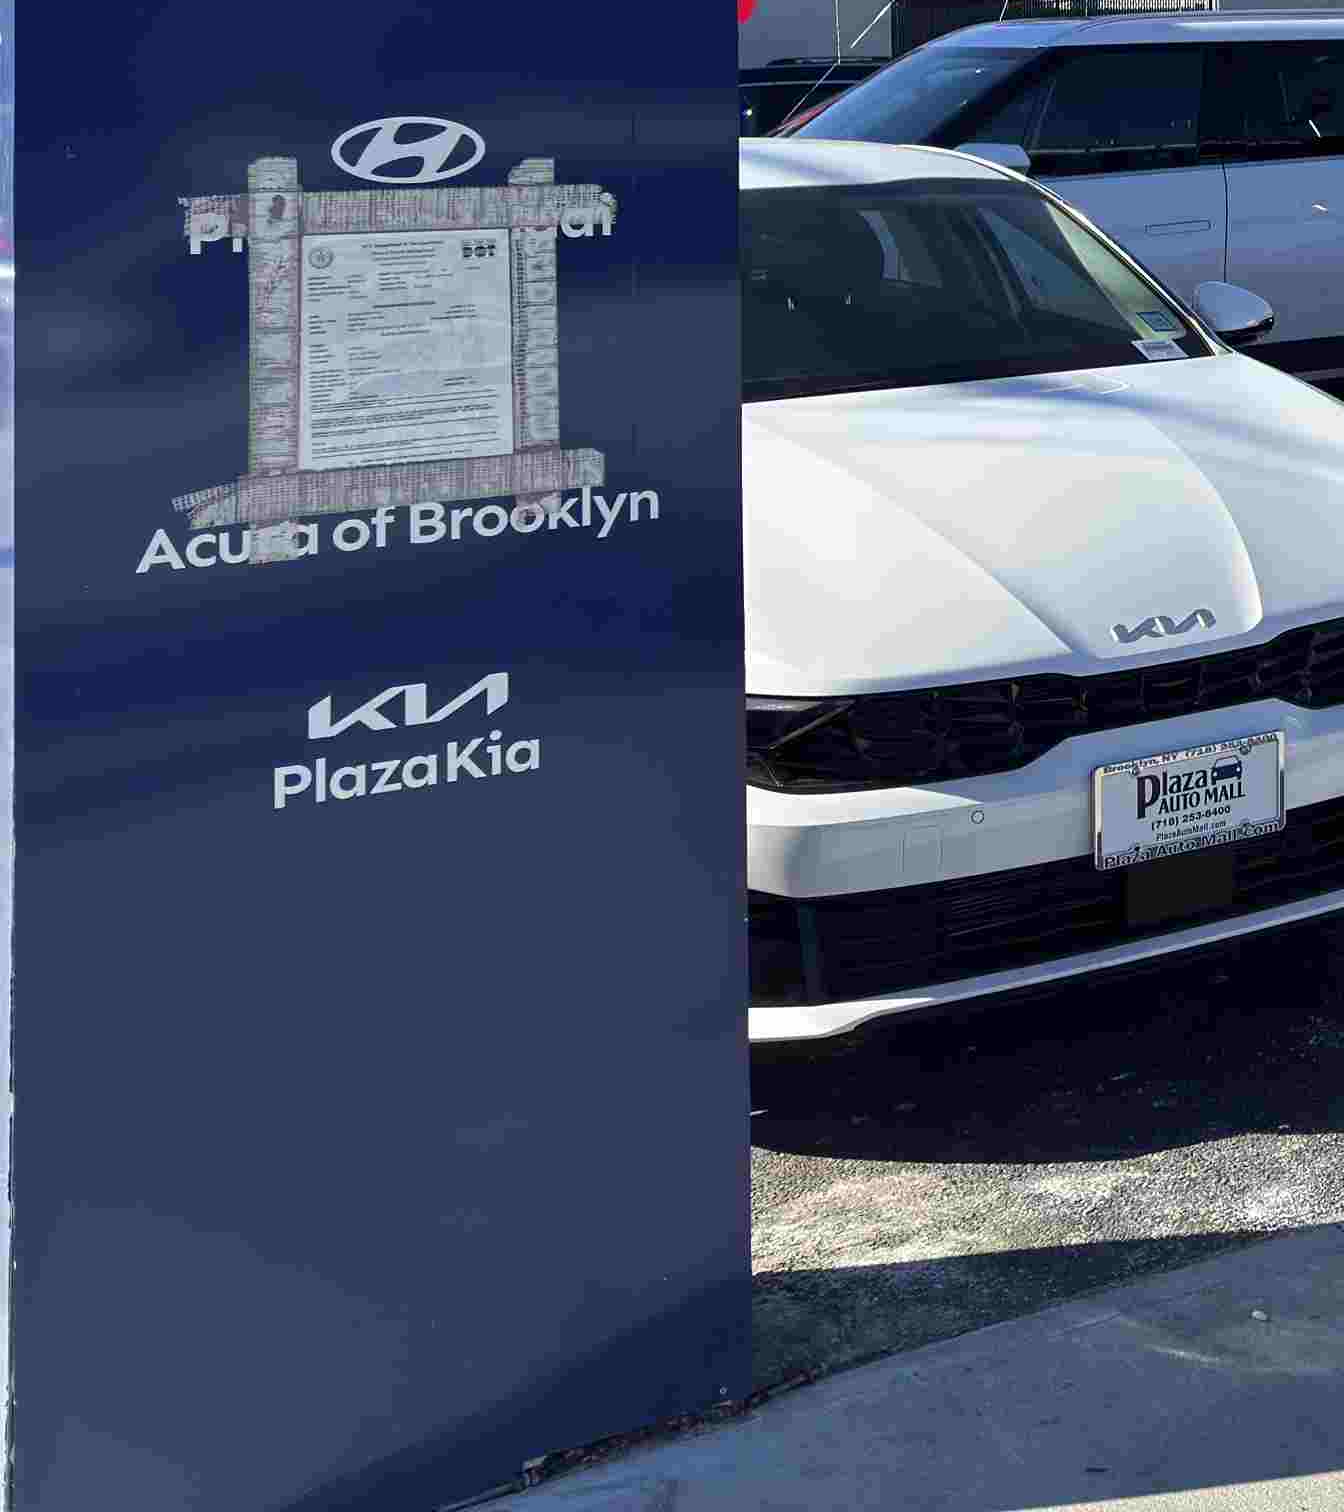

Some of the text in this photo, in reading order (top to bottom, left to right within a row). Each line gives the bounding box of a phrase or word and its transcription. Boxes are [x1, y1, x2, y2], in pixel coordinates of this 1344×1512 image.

[136, 485, 659, 574] Acua of Brooklyn
[1136, 768, 1208, 819] Plaza
[1158, 781, 1246, 815] AUTO MALL
